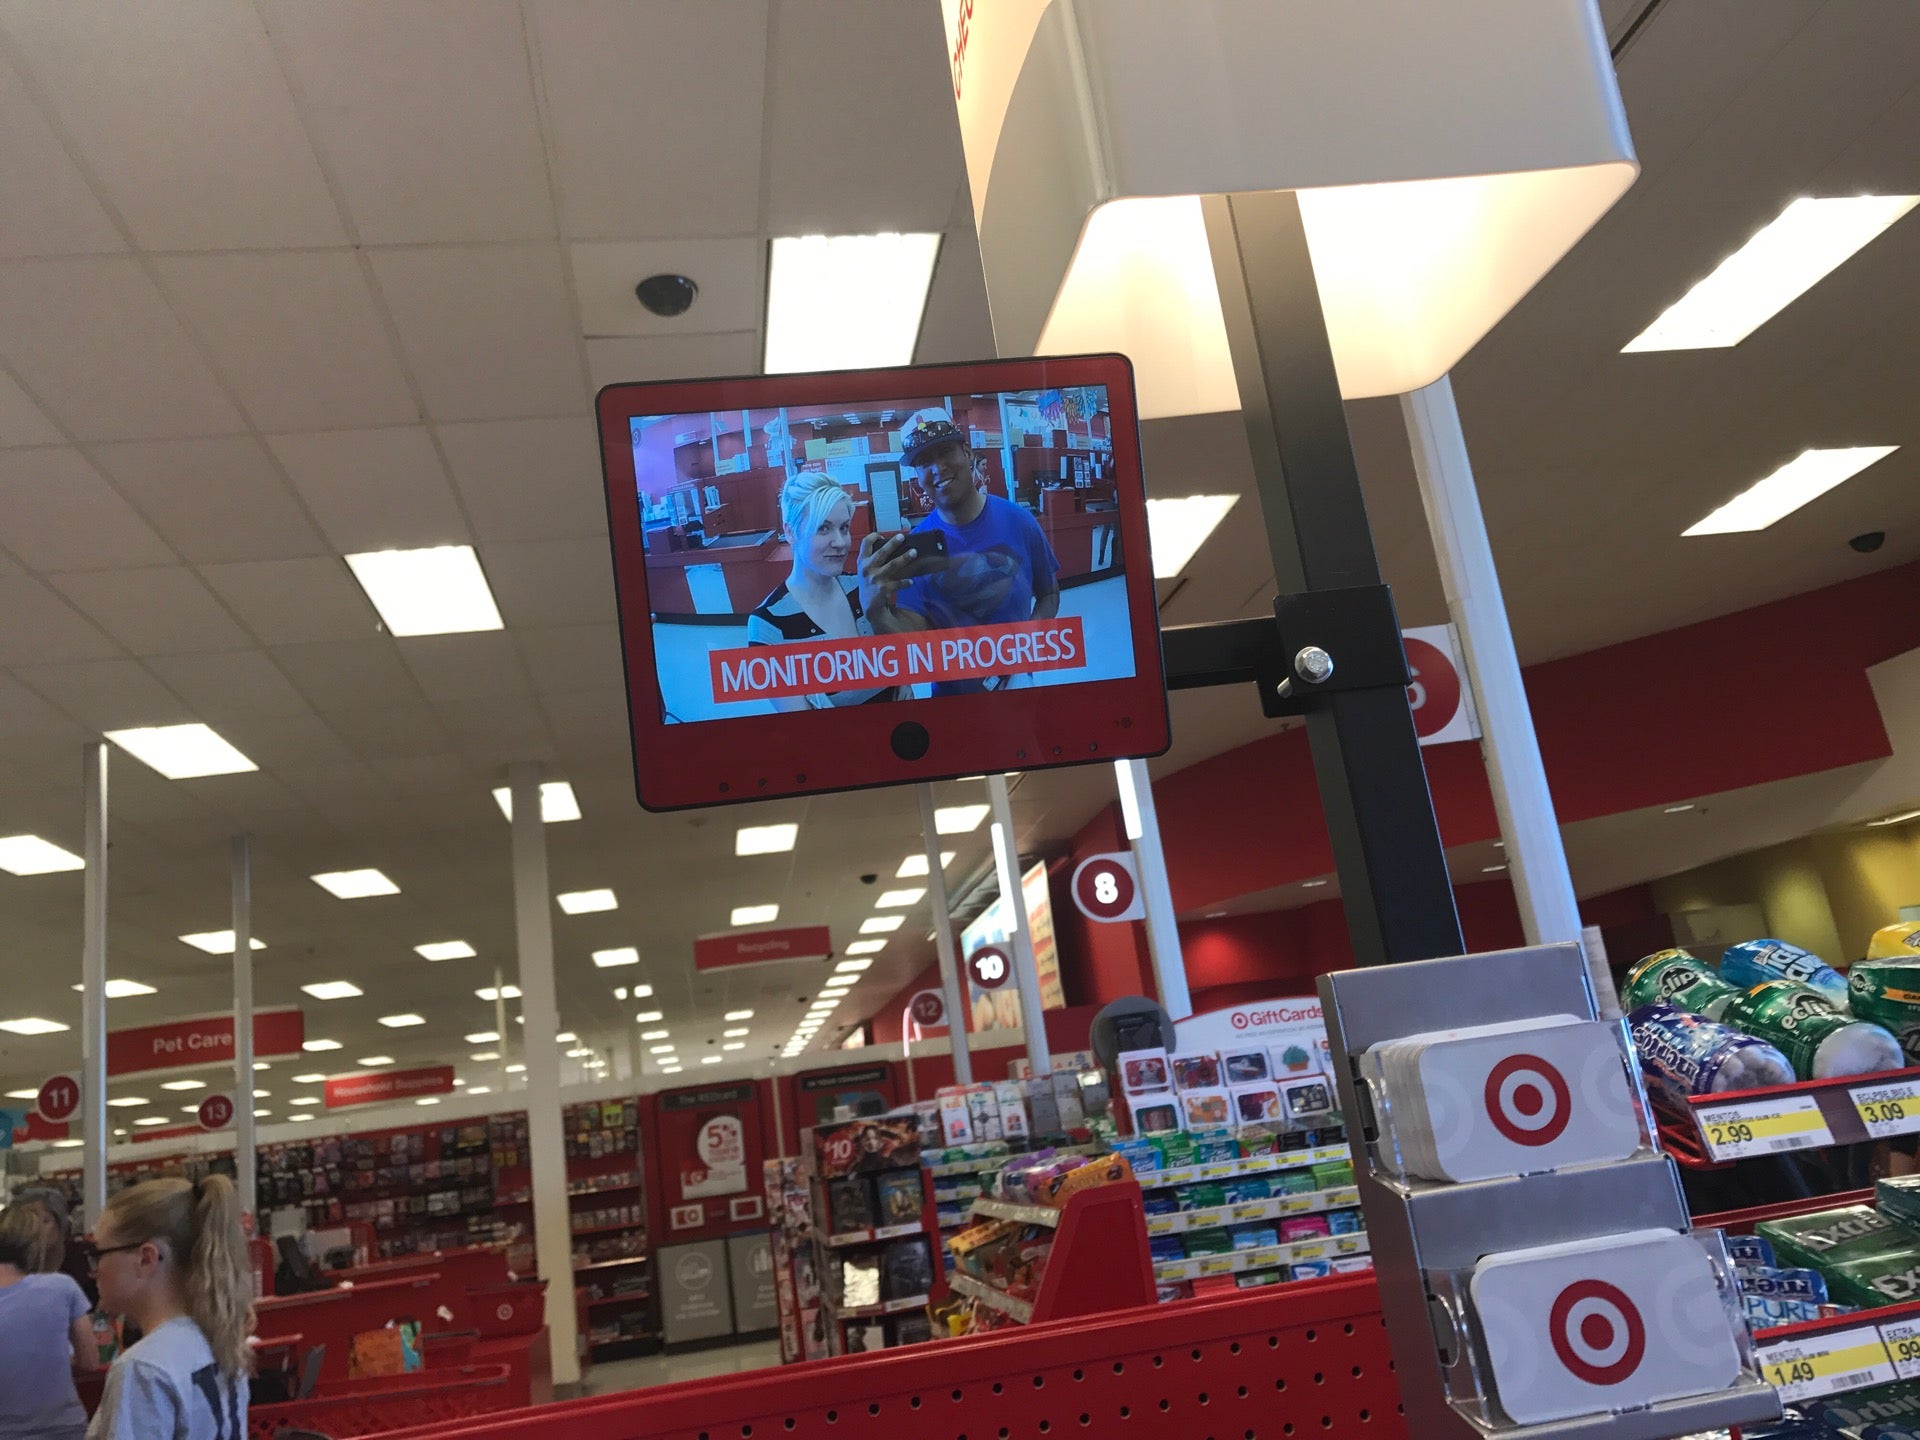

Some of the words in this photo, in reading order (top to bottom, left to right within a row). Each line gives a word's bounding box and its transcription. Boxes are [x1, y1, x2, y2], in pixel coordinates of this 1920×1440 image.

[720, 645, 898, 693] MONITORING
[908, 642, 934, 674] IN
[941, 628, 1076, 671] PROGRESS
[1094, 872, 1119, 904] 8
[975, 954, 1005, 981] 10
[1655, 970, 1704, 1003] eclip
[917, 1000, 938, 1017] 12
[1250, 1005, 1324, 1026] GiftCards
[152, 1036, 184, 1055] Pet
[187, 1032, 233, 1051] Care
[49, 1086, 71, 1109] 11
[206, 1103, 227, 1120] 13
[1703, 1110, 1742, 1124] MENTOS
[1864, 1103, 1905, 1124] 3.09
[707, 1123, 738, 1149] 5%
[1711, 1124, 1753, 1146] 2.99
[823, 1139, 852, 1159] $10
[1886, 1327, 1914, 1340] EXTRA
[1766, 1347, 1803, 1361] MENTOS
[1774, 1361, 1815, 1386] 1.49
